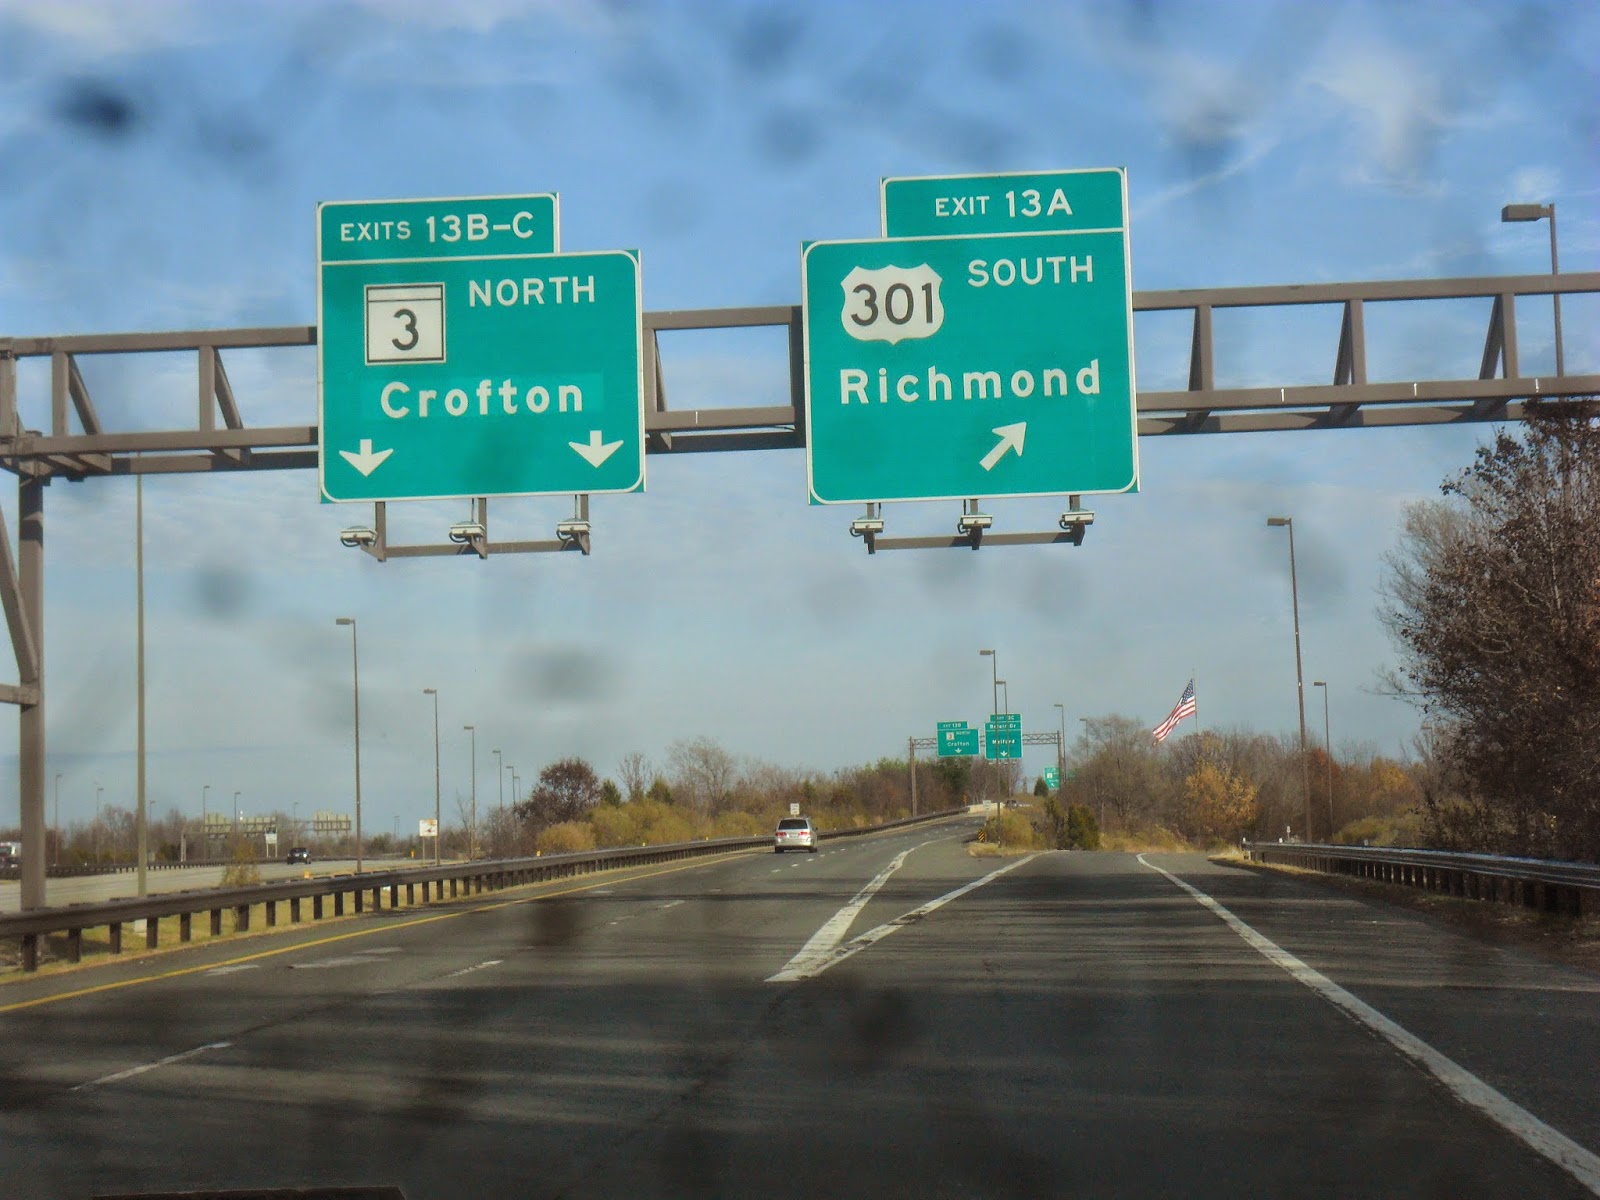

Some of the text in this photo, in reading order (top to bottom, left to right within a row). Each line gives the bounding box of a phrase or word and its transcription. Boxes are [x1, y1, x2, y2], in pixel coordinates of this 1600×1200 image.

[935, 188, 1073, 218] EXIT 13A
[340, 211, 534, 243] EXITS 13B-C
[968, 255, 1093, 287] SOUTH
[468, 275, 595, 307] NORTH
[850, 282, 934, 327] 301
[391, 308, 420, 351] 3
[380, 379, 583, 419] Crofton
[840, 358, 1101, 404] Richmond
